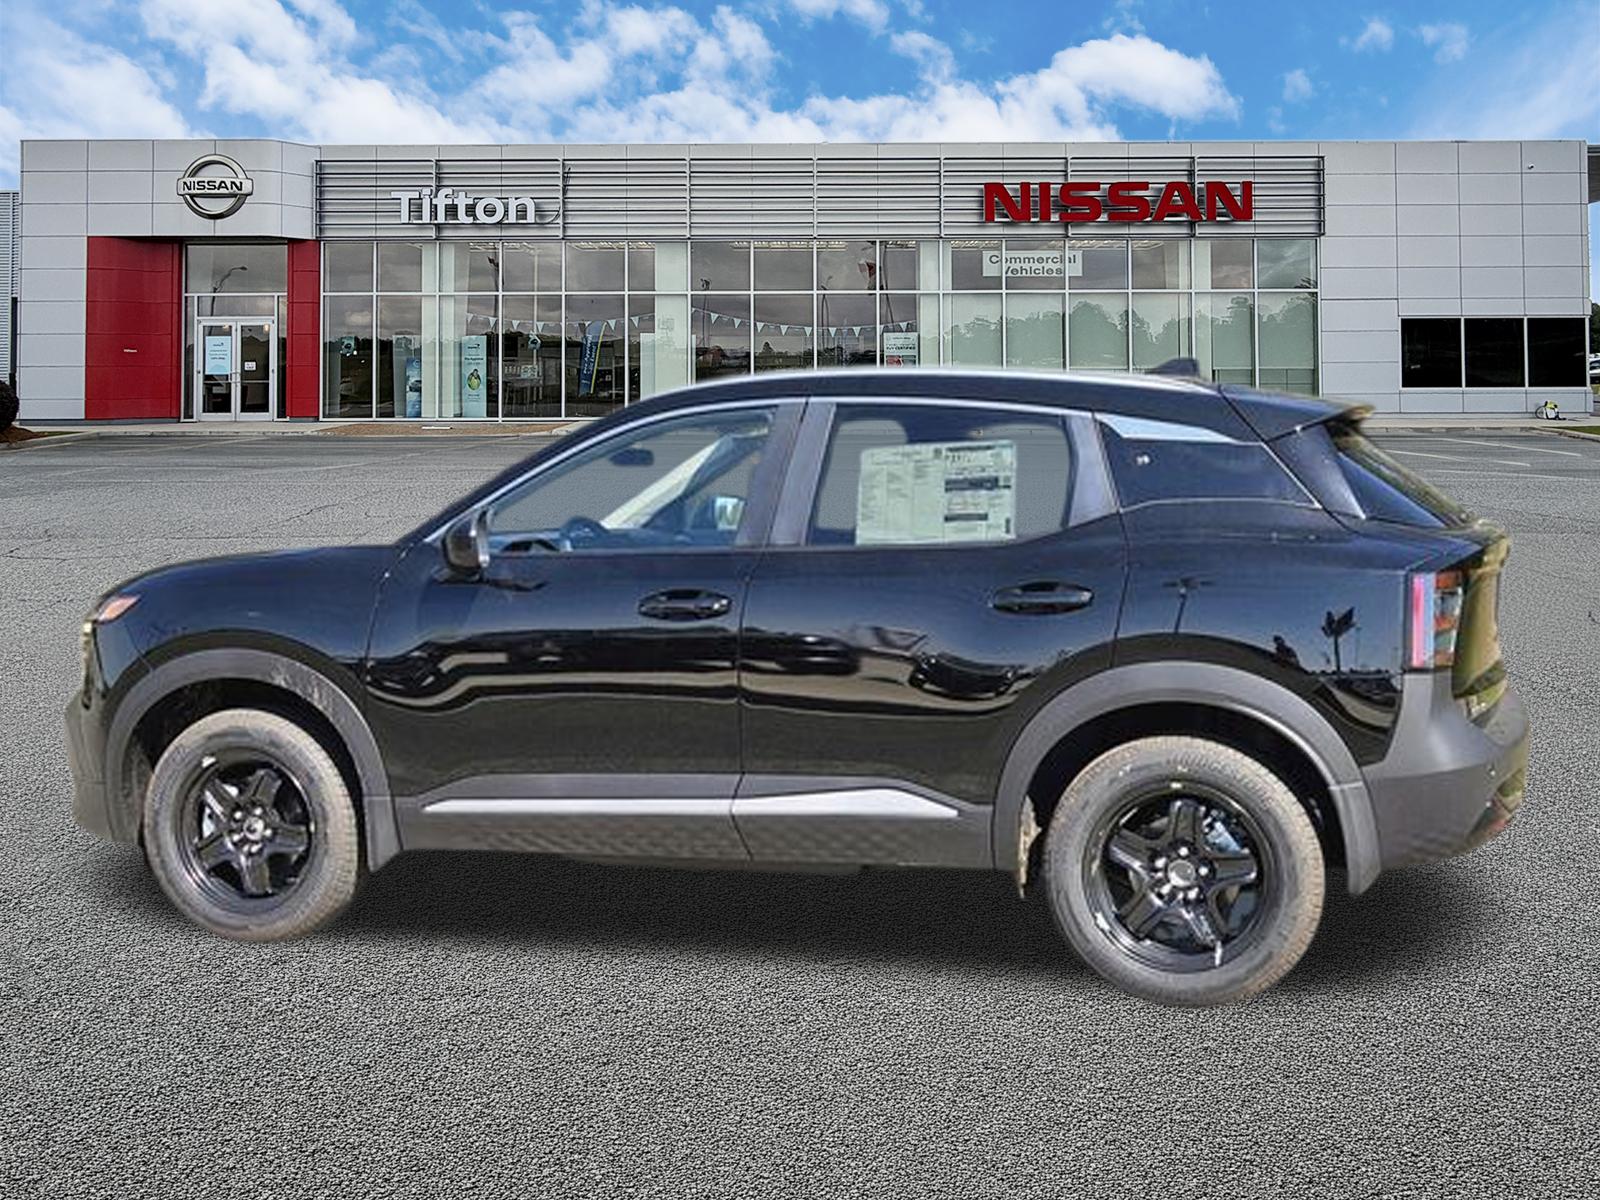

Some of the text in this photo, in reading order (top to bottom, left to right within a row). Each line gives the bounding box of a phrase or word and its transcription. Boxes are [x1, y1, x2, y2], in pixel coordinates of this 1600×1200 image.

[182, 180, 243, 192] NISSAN
[983, 180, 1253, 223] NISSAN
[390, 187, 535, 224] Tifton
